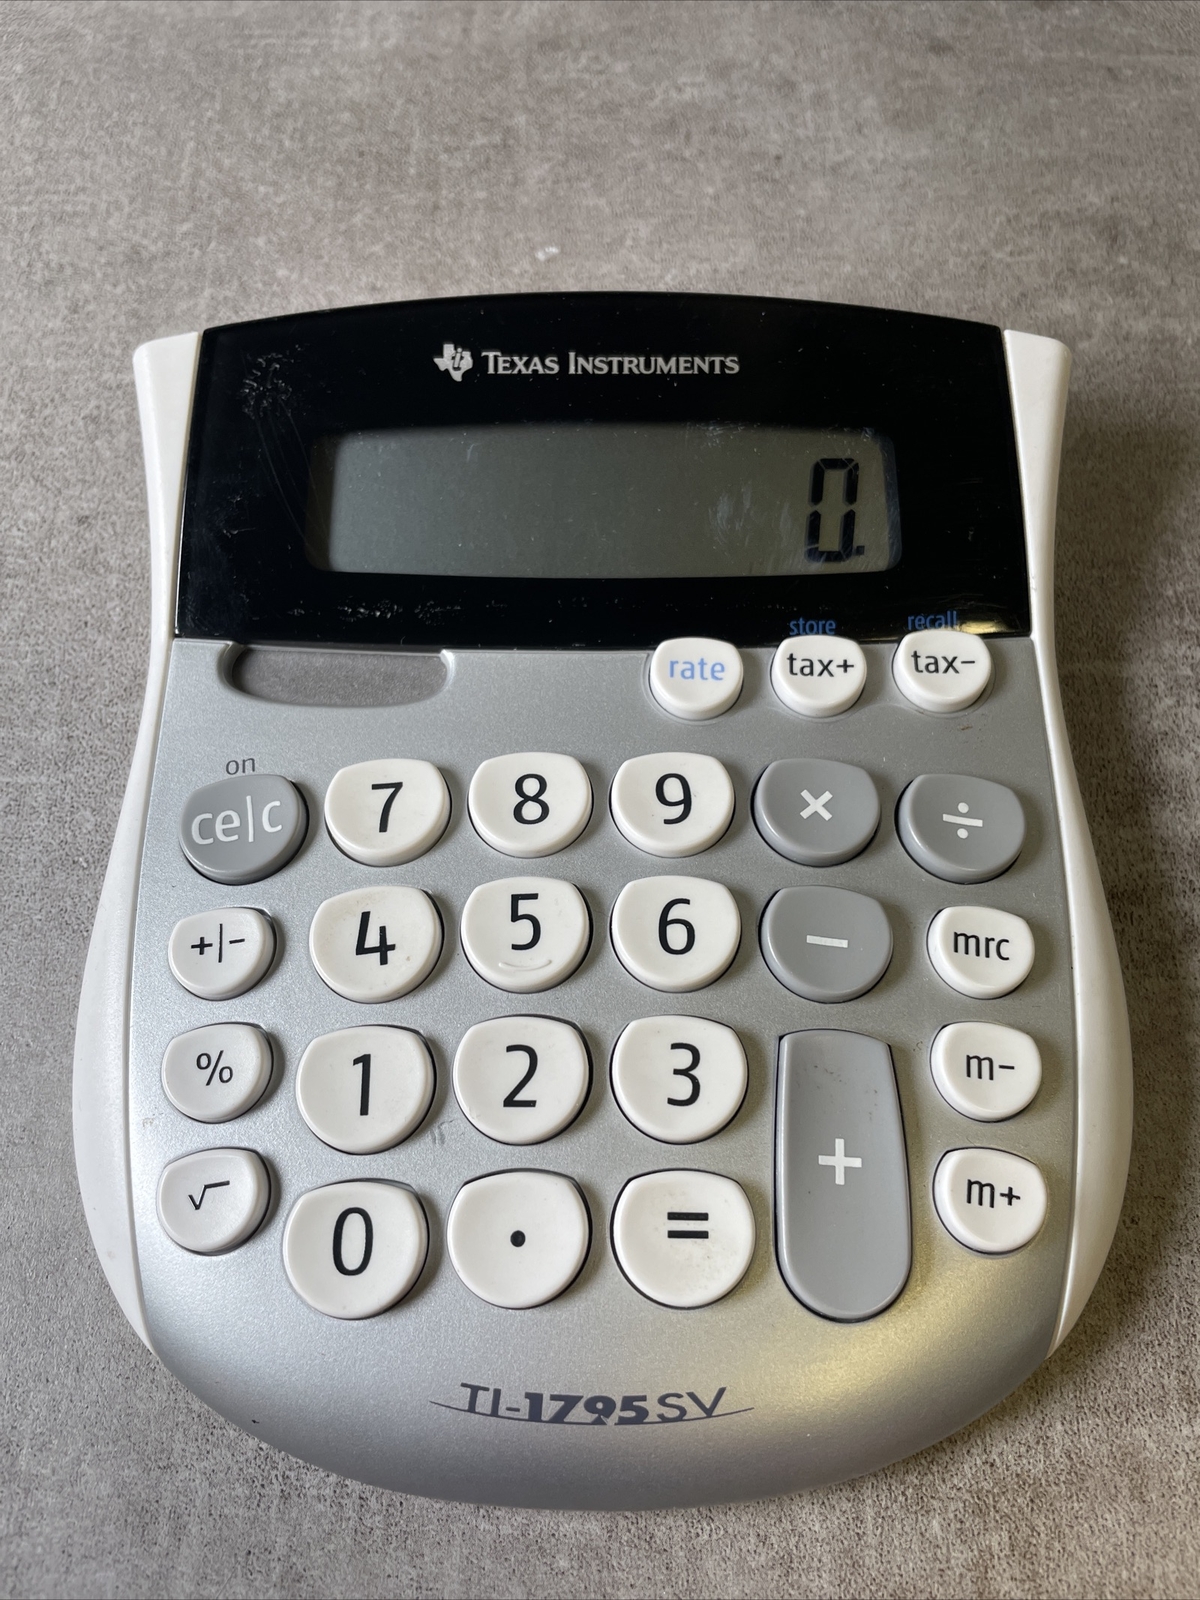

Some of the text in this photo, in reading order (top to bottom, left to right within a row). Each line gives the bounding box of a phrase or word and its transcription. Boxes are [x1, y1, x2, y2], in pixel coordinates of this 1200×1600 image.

[481, 351, 740, 375] TEXAS INSTRUMENTS
[789, 617, 836, 635] store
[907, 611, 958, 630] recall
[669, 657, 725, 682] rate
[787, 652, 855, 678] tax+
[225, 757, 257, 776] on
[371, 781, 404, 833] 7
[513, 773, 550, 826] 8
[654, 772, 692, 826] 9
[355, 910, 397, 966] 4
[510, 892, 542, 951] 5
[657, 897, 696, 956] 6
[953, 929, 1011, 963] mrc
[196, 1049, 234, 1089] %
[352, 1053, 372, 1116] 1
[502, 1043, 539, 1109] 2
[666, 1042, 702, 1108] 3
[966, 1176, 1021, 1210] m+
[332, 1206, 374, 1276] 0
